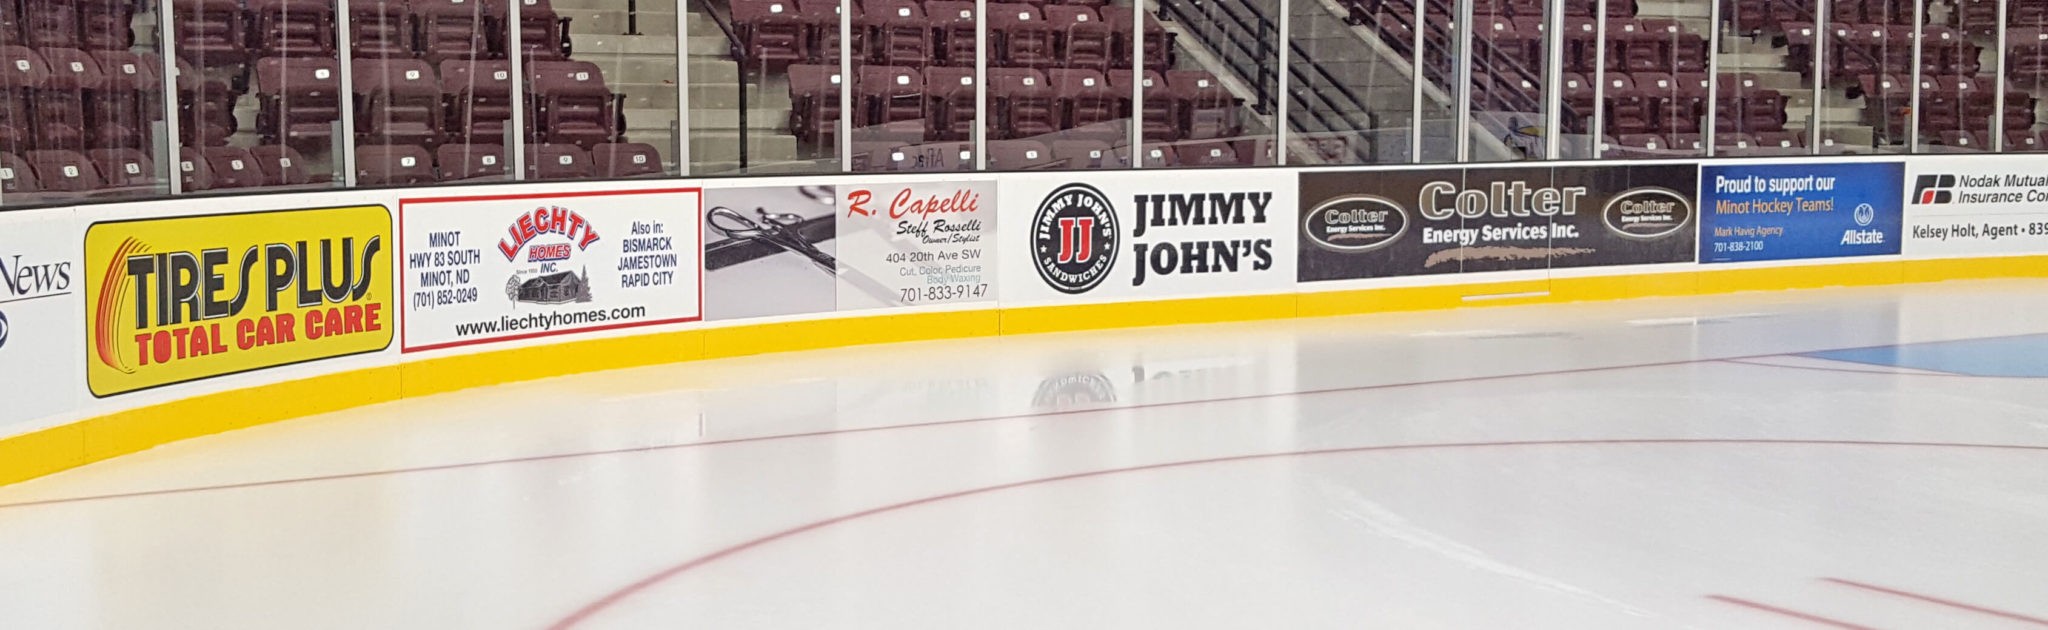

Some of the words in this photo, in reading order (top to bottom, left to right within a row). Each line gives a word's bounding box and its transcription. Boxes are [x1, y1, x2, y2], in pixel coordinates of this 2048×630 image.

[1715, 175, 1750, 194] Proud
[1754, 177, 1766, 193] to
[1769, 177, 1813, 197] support
[1816, 176, 1836, 192] our
[1959, 174, 2001, 188] Nodak
[847, 189, 876, 218] R.
[889, 188, 979, 220] Capelli
[1418, 181, 1586, 220] Colter
[1958, 190, 2023, 204] Insurance
[2027, 189, 2048, 202] Co
[1132, 191, 1272, 238] JIMMY
[1620, 200, 1675, 214] Colter
[1715, 198, 1750, 215] Minot
[1752, 197, 1794, 217] Hockey
[1795, 197, 1834, 213] Teams!
[1039, 194, 1074, 240] JIMMY
[1076, 194, 1112, 239] JOHN'S
[1324, 209, 1388, 224] Colter
[498, 205, 600, 262] LIECHTY
[631, 222, 650, 234] Also
[652, 221, 663, 234] in:
[896, 220, 928, 238] Steff
[933, 219, 981, 234] Rosselli
[1326, 226, 1347, 234] Energy
[1423, 226, 1478, 245] Energy
[1482, 223, 1548, 241] Services
[1551, 222, 1579, 238] Inc.
[1714, 227, 1732, 237] Mark
[1756, 226, 1784, 238] Agency
[1913, 223, 1948, 241] Kelsey
[1951, 223, 1979, 239] Holt,
[1982, 223, 2018, 241] Agent
[429, 231, 461, 248] MINOT
[622, 237, 672, 253] BISMARCK
[922, 233, 980, 245] Owner/Stylist
[1057, 217, 1094, 264] JJ
[1840, 229, 1884, 246] Allstate
[528, 243, 571, 262] HOMES
[886, 252, 906, 263] 404
[909, 250, 935, 262] 20th
[938, 250, 959, 261] Ave
[961, 249, 981, 259] SW
[1714, 241, 1764, 253] 701-838-2100
[409, 254, 431, 269] HWY
[434, 253, 445, 267] 83
[447, 249, 480, 265] SOUTH
[540, 262, 558, 274] INC.
[617, 253, 677, 271] JAMESTOWN
[1132, 238, 1273, 286] JOHN'S
[0, 254, 71, 296] News
[420, 271, 453, 287] MINOT,
[455, 269, 470, 284] ND
[945, 265, 981, 274] Pedicure
[1043, 254, 1108, 284] SANDWICHES
[127, 245, 258, 329] TIRES
[265, 235, 380, 311] PLUS
[621, 273, 650, 288] RAPID
[652, 271, 673, 286] CITY
[950, 274, 981, 284] Waxing
[413, 291, 435, 311] (701)
[437, 287, 478, 305] 852-0249
[900, 284, 988, 303] 701-833-9147
[456, 304, 645, 336] www.liechtyhomes.com
[134, 324, 227, 366] TOTAL
[236, 311, 296, 350] CAR
[305, 303, 381, 337] CARE
